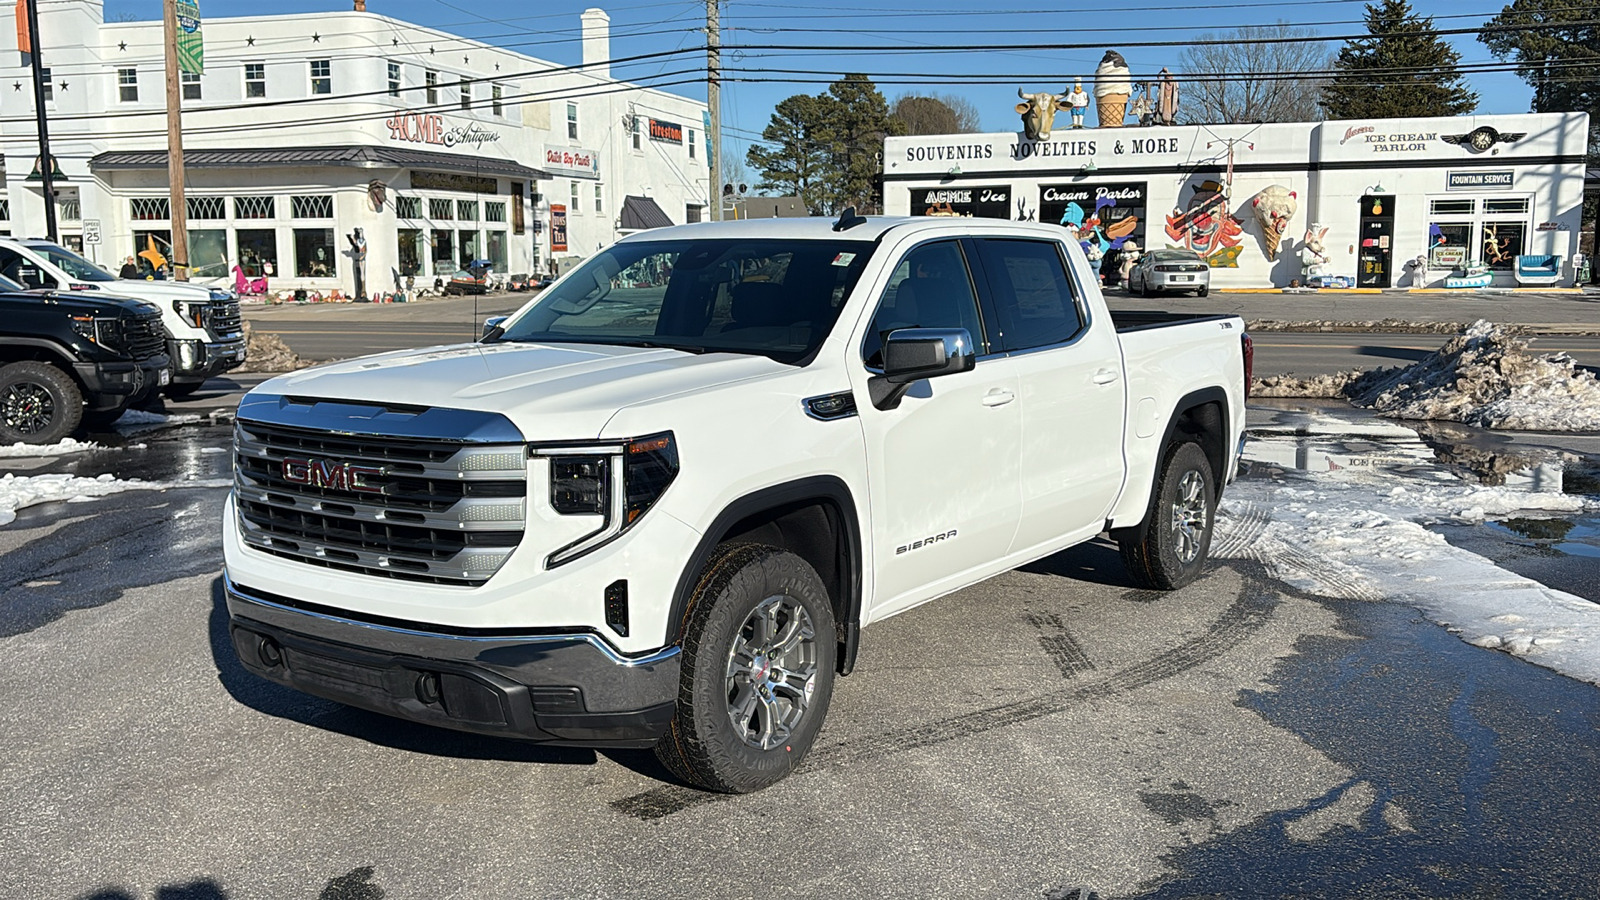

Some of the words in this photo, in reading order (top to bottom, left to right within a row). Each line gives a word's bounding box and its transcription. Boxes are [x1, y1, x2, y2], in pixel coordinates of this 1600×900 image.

[386, 110, 445, 145] ACME
[444, 120, 500, 150] Antiques
[1365, 134, 1386, 143] ICE
[1389, 132, 1438, 142] CREAM
[906, 144, 993, 161] SOUVENIRS
[1009, 140, 1097, 158] NOVELTIES
[1113, 139, 1125, 155] &
[1131, 137, 1179, 154] MORE
[1373, 143, 1427, 152] PARLOR
[563, 152, 574, 168] Boy
[1451, 175, 1483, 185] FOUNTAIN
[1484, 174, 1512, 184] SERVICE
[925, 190, 972, 204] ACME
[979, 189, 1008, 203] Ice
[1043, 188, 1089, 201] Cream
[1095, 187, 1142, 200] Parlor
[86, 232, 100, 242] 25
[283, 457, 386, 494] GMC
[895, 529, 958, 555] SIERRA
